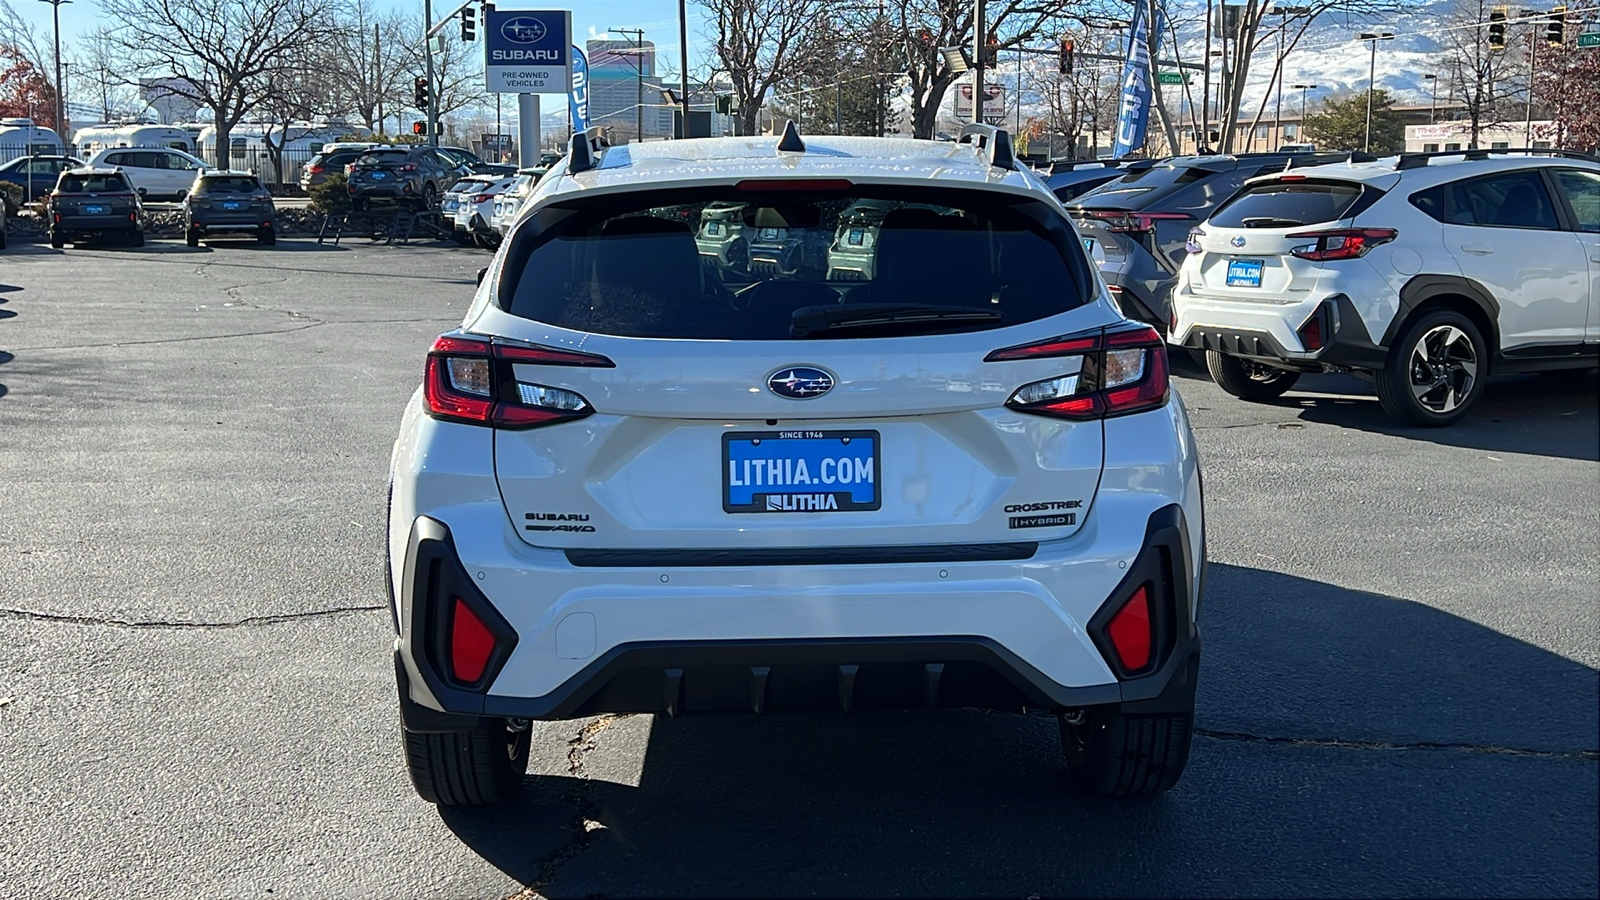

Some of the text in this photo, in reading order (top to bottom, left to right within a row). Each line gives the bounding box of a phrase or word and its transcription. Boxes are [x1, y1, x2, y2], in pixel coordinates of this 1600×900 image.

[492, 49, 559, 60] SUBARU
[501, 71, 549, 79] PRE-OWNED
[779, 431, 824, 439] SINCE 1946
[729, 457, 874, 486] LITHIA.COM
[782, 494, 838, 510] LITHIA
[1004, 500, 1083, 513] CROSSTREK
[525, 512, 590, 521] SUBARU
[1020, 517, 1066, 526] HYBRID
[551, 525, 597, 533] AWD
